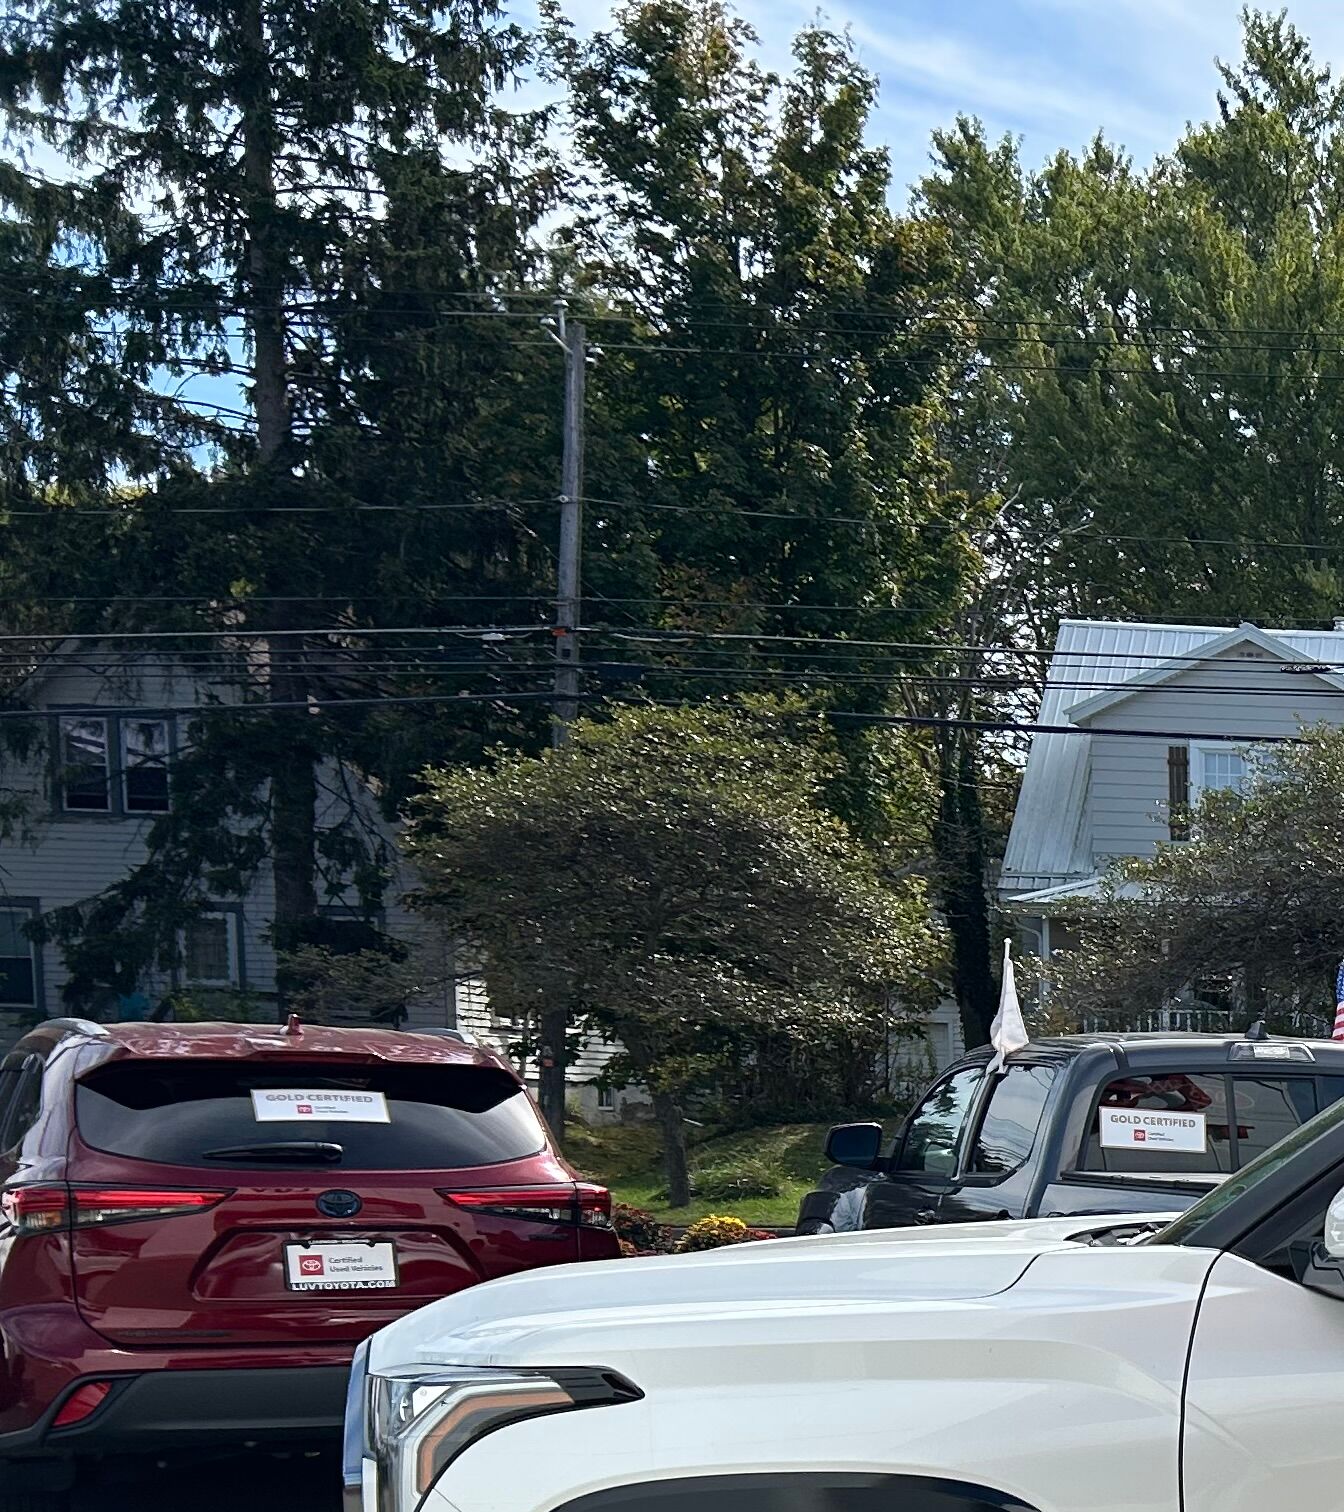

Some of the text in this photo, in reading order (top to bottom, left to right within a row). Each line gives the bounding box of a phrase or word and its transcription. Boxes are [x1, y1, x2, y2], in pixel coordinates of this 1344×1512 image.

[265, 1093, 373, 1103] GOLD CERTIFIED
[1110, 1114, 1196, 1128] GOLD CERTIFIED
[328, 1256, 363, 1264] Certified
[291, 1280, 396, 1291] LUVTOYOTA.COM
